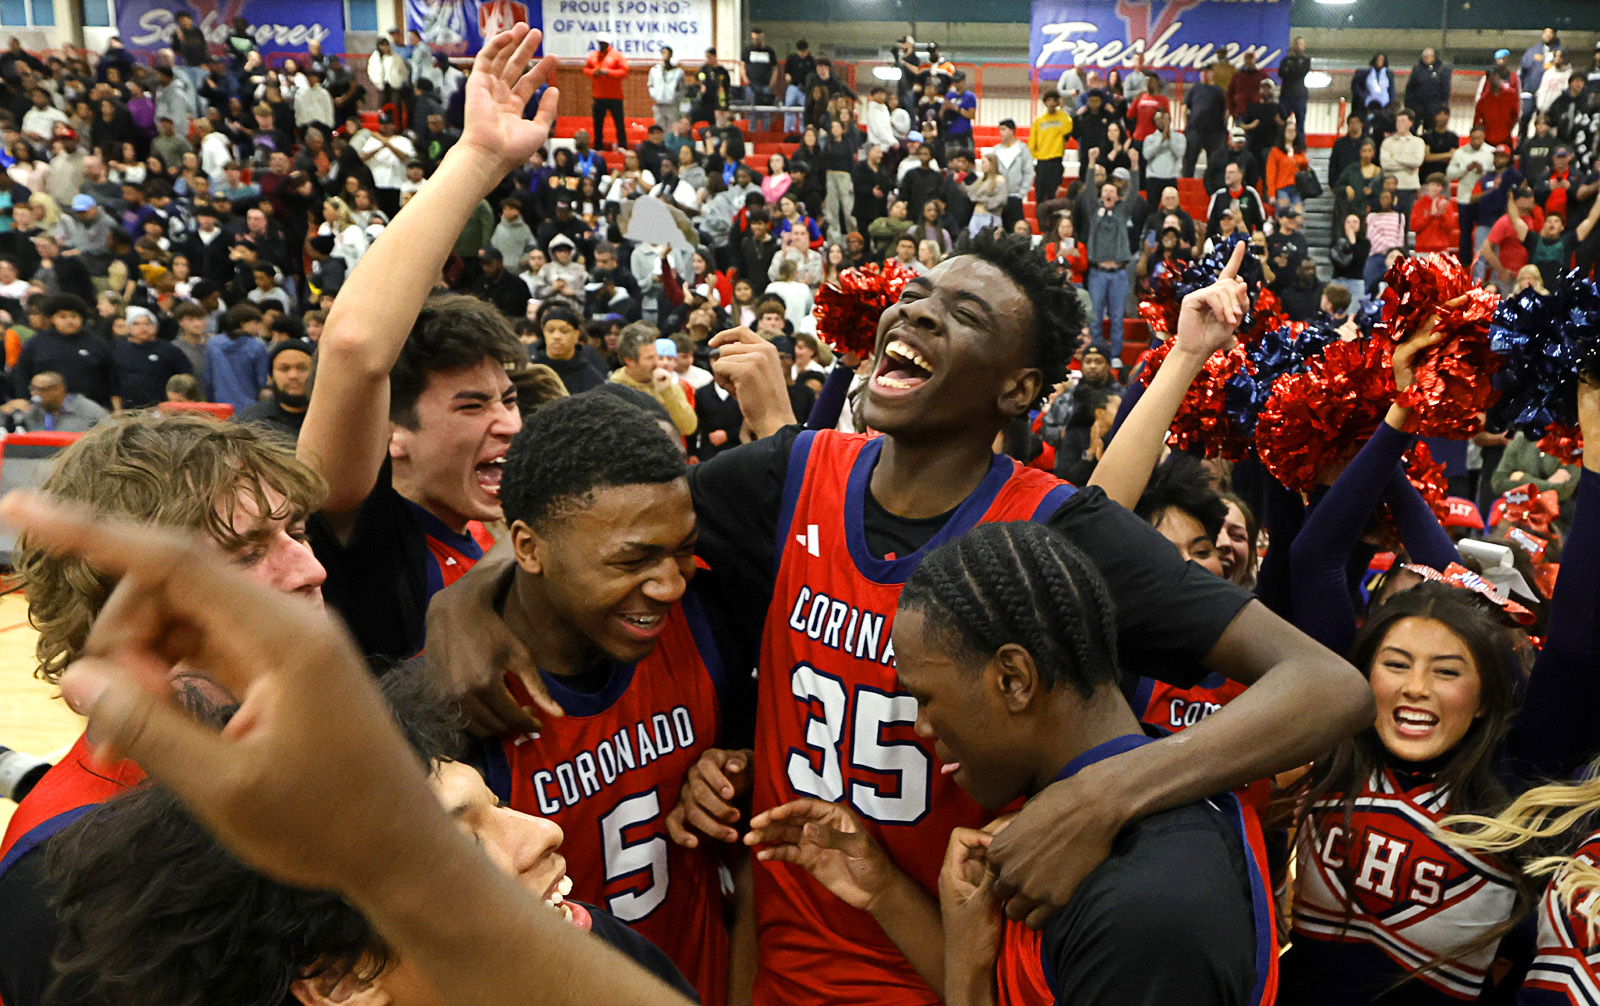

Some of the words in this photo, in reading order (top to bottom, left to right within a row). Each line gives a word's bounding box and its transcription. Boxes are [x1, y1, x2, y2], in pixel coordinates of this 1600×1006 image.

[131, 8, 329, 46] Sohoores
[553, 19, 575, 32] OF
[578, 20, 631, 33] VALLEY
[636, 20, 698, 34] VIKINGS
[587, 39, 665, 53] ALETICS
[1450, 503, 1472, 517] LEY
[533, 705, 695, 815] CORONADO
[787, 662, 931, 825] 35
[601, 788, 670, 924] 5
[1322, 826, 1445, 905] CHS
